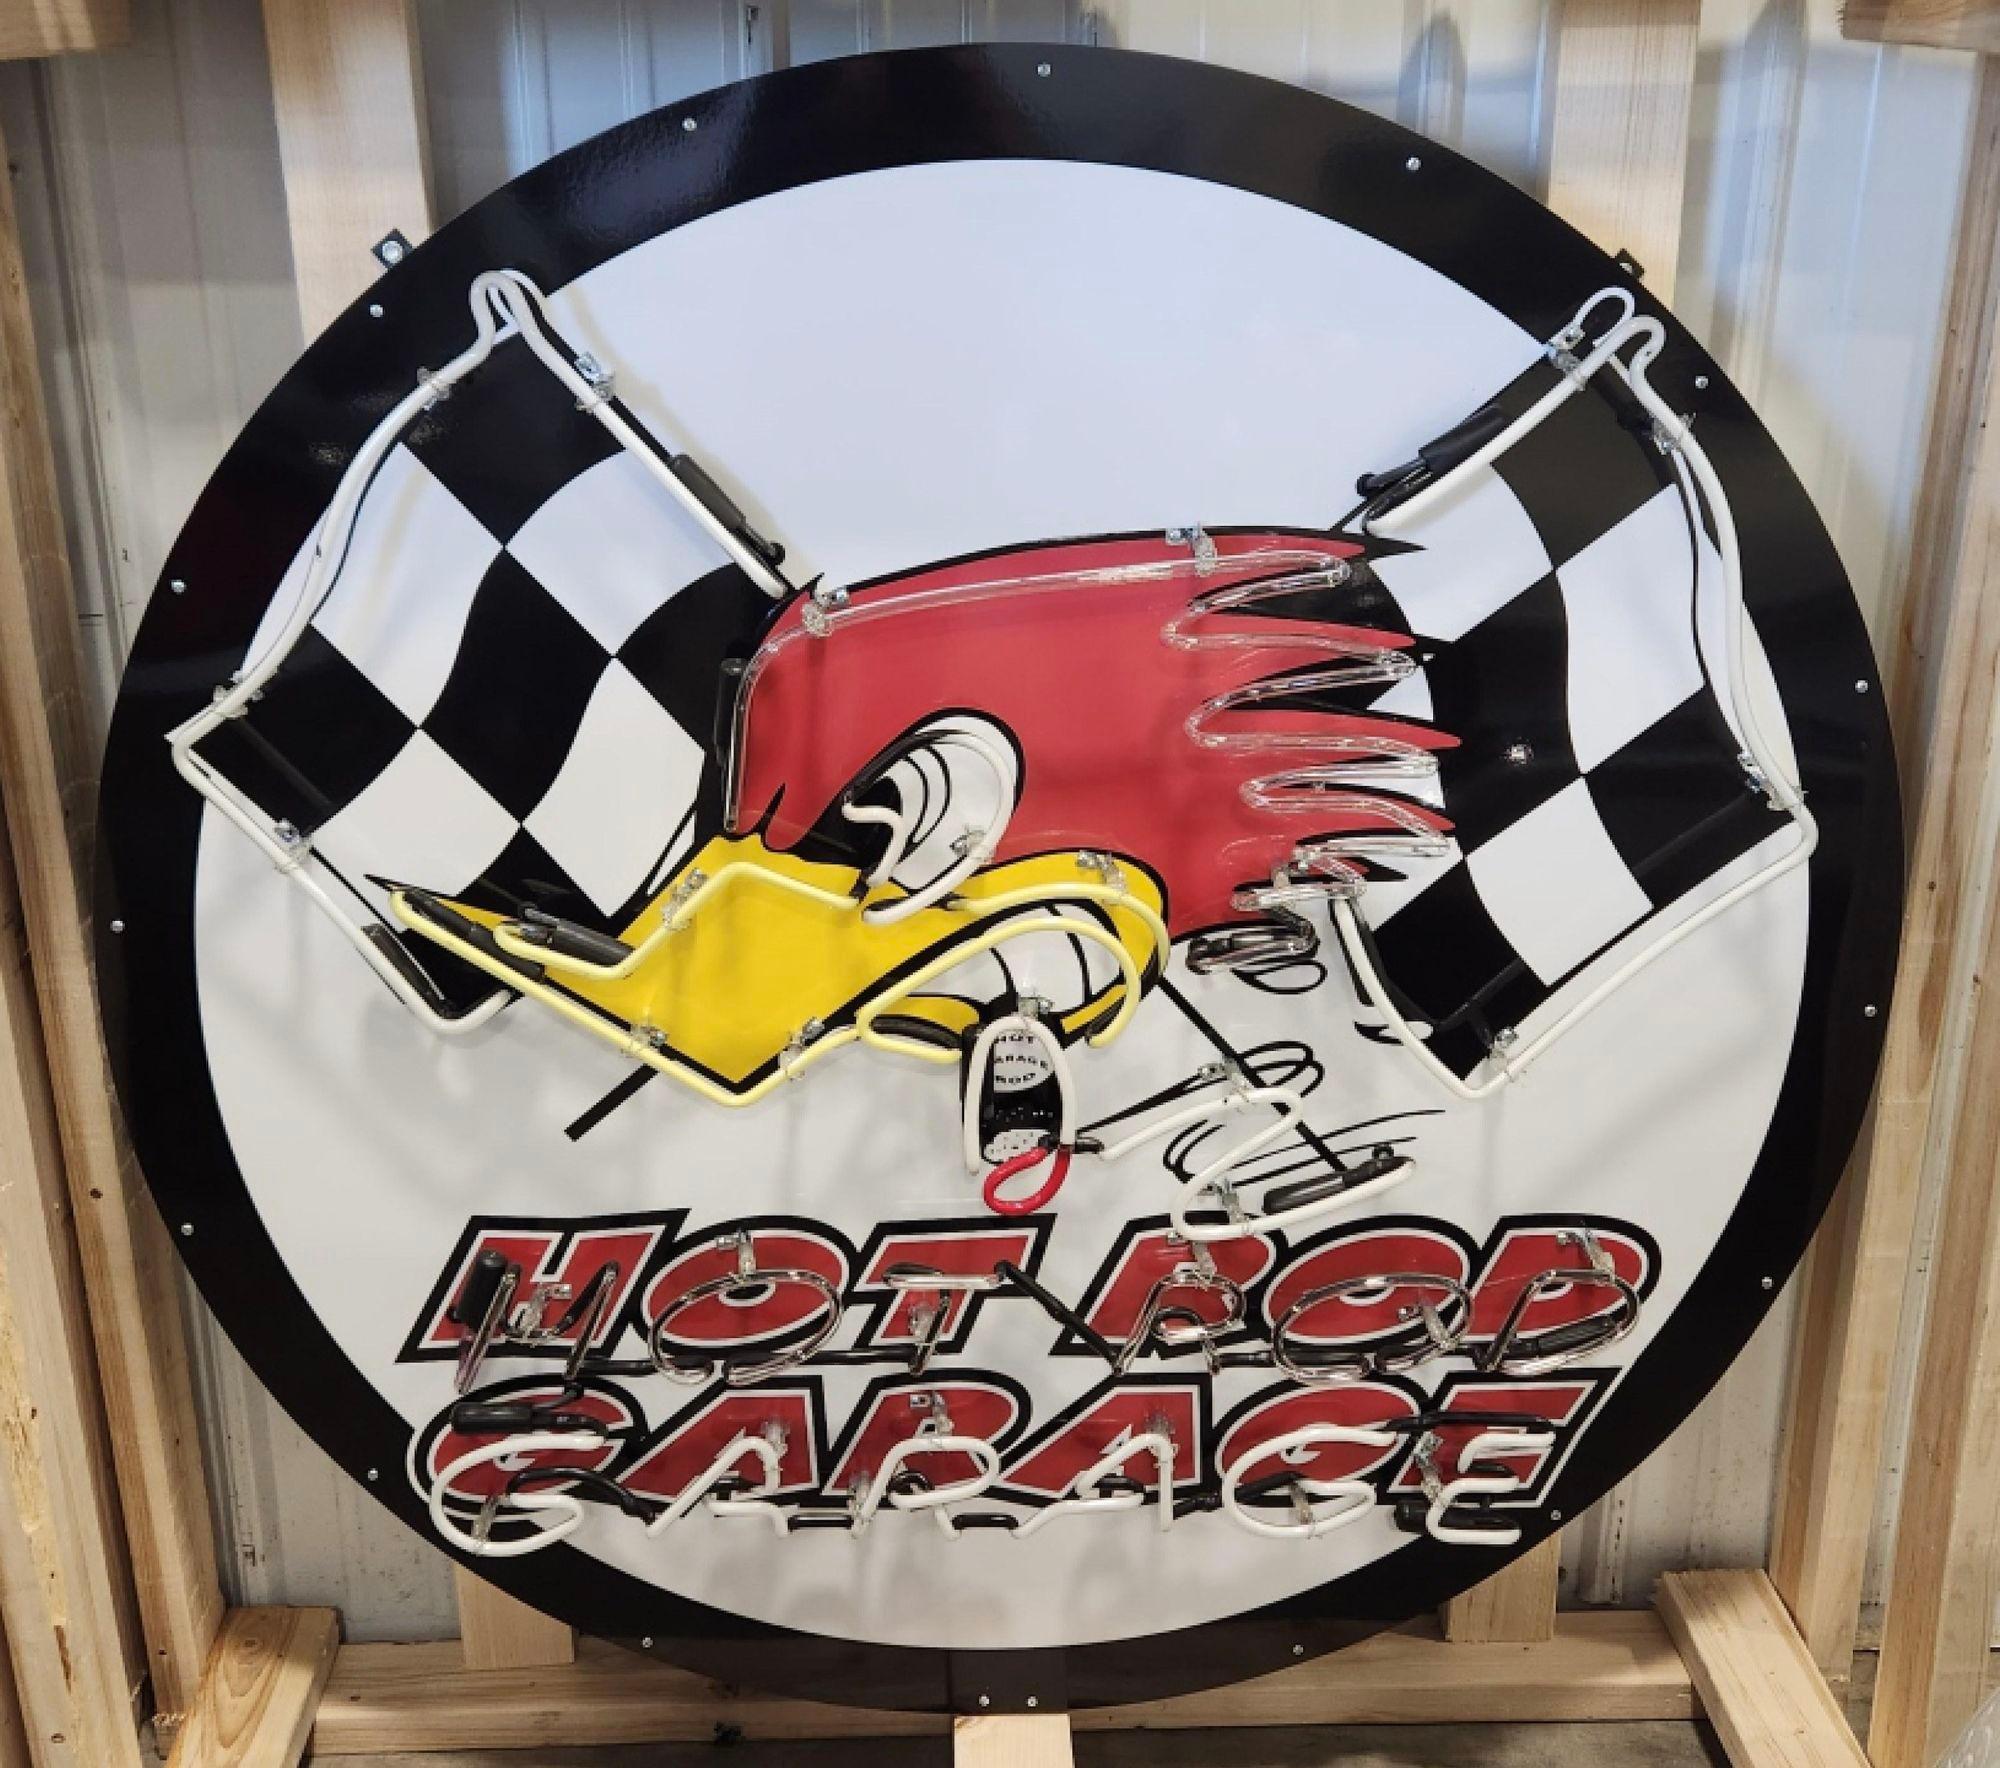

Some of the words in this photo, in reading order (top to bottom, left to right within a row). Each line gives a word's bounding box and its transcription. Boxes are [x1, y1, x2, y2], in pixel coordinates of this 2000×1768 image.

[396, 1208, 1056, 1378] HOT
[1050, 1212, 1662, 1375] ROD
[405, 1368, 1622, 1545] GARAGE
